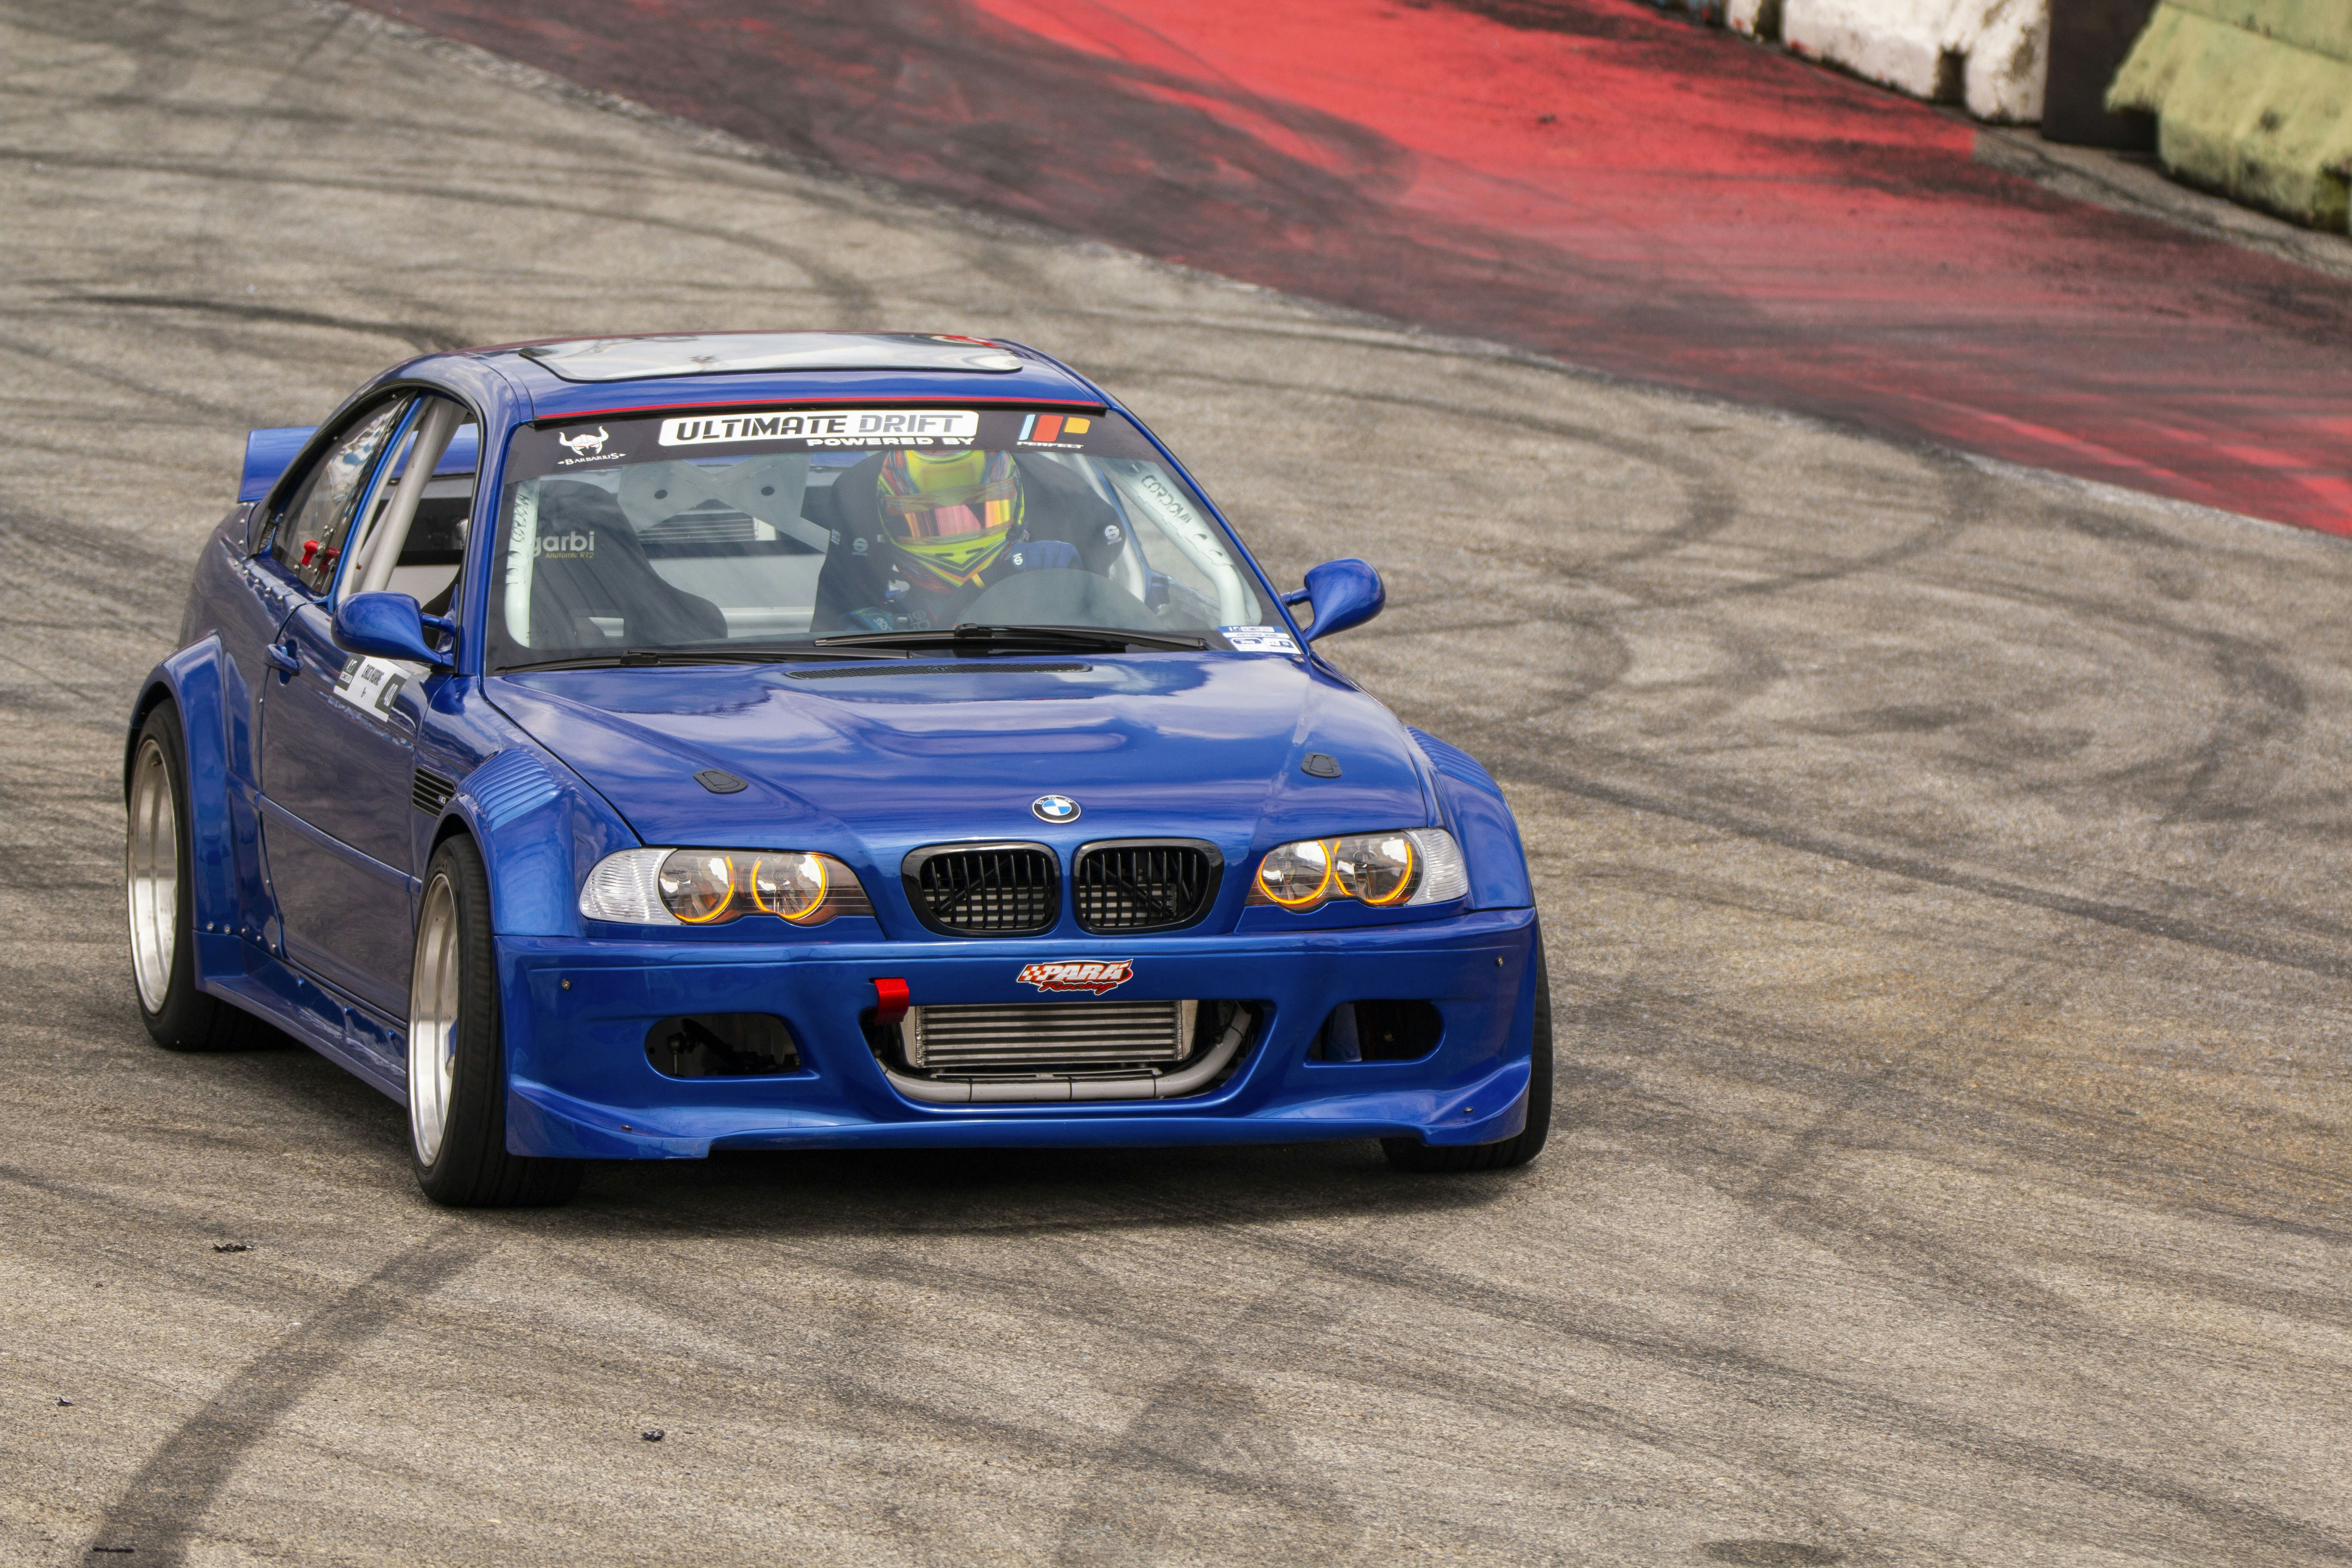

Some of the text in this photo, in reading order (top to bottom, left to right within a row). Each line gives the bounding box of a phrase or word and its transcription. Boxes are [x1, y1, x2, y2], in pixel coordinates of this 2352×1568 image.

[676, 414, 963, 441] ULTIMATE DRIFT
[806, 437, 975, 446] POWERED BY
[565, 453, 619, 466] BARBARIUS
[1141, 475, 1192, 523] CORDOVA
[1040, 982, 1117, 994] Racing
